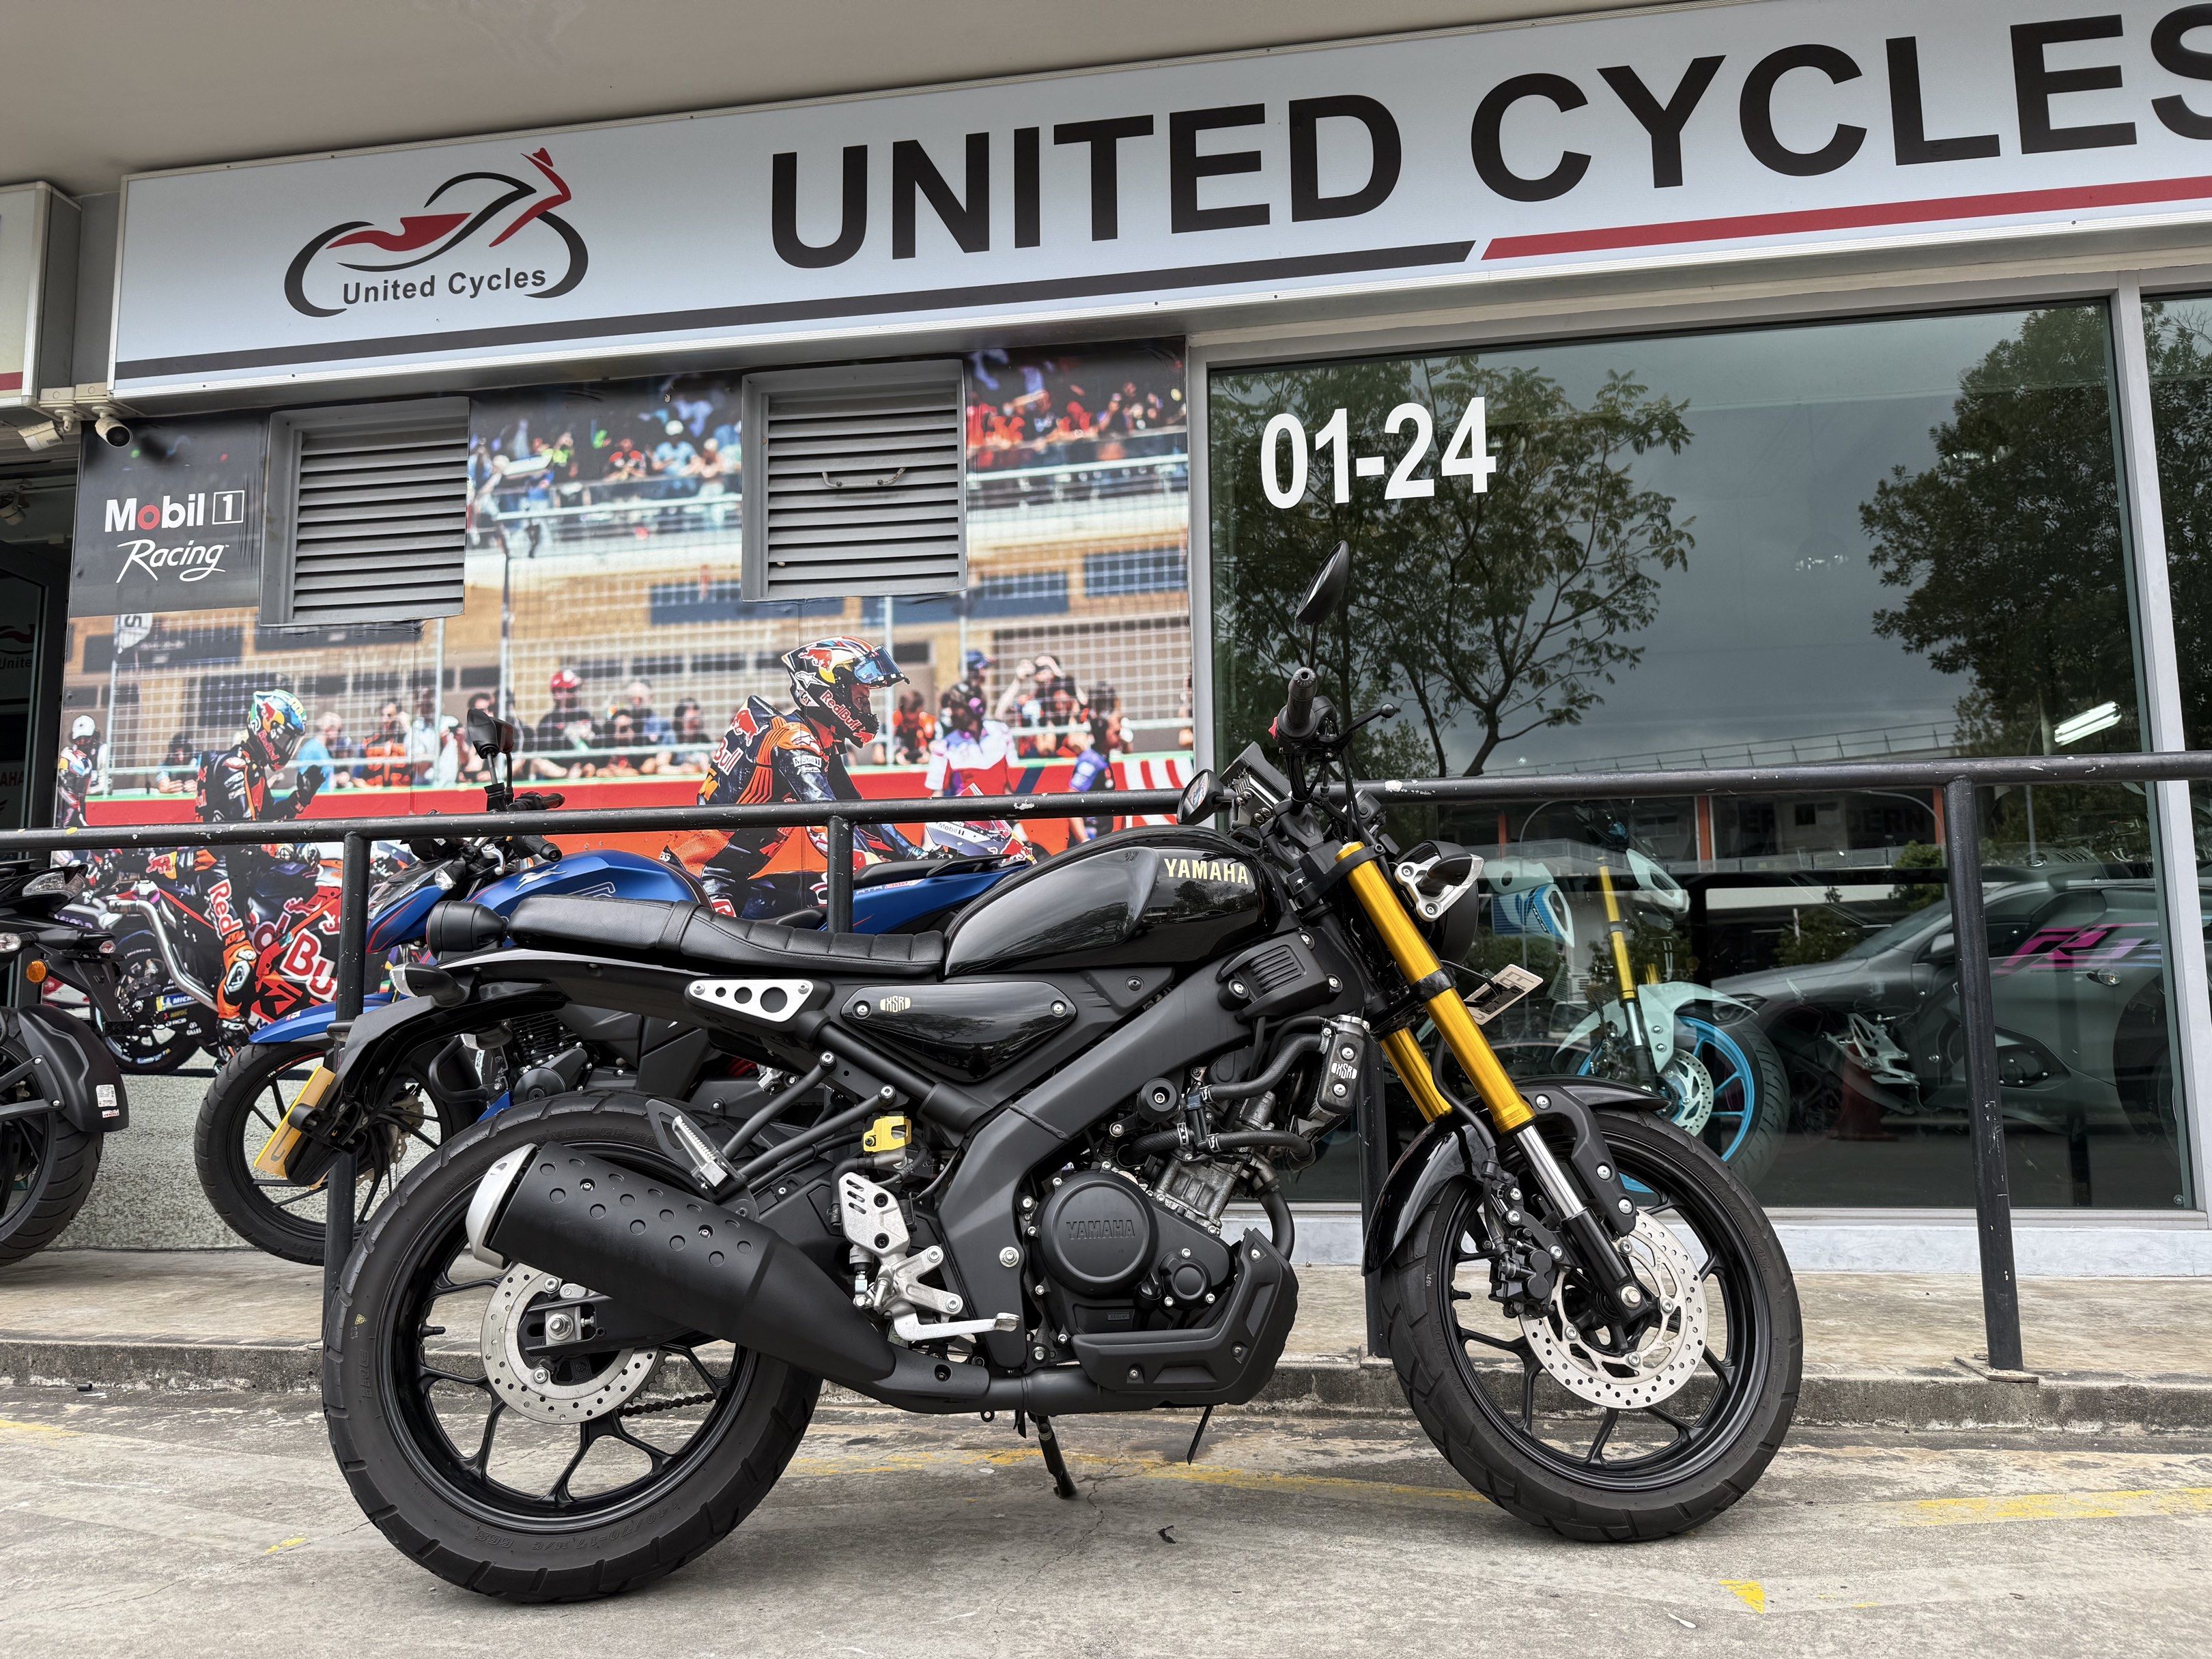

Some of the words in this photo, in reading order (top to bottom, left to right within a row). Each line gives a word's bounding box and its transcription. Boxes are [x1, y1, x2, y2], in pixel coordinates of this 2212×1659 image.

[771, 94, 1402, 269] UNITED
[343, 274, 436, 304] United
[448, 268, 546, 298] Cycles
[1261, 396, 1497, 509] 01-24
[104, 492, 205, 533] Mobil
[115, 539, 227, 584] Racing
[0, 656, 32, 669] Unite
[938, 822, 958, 835] Mobil
[1163, 858, 1249, 885] YAMAHA
[207, 879, 244, 936] Red
[280, 928, 338, 1003] Bu
[885, 995, 905, 1012] XSR
[1334, 1062, 1355, 1079] XSR
[1066, 1219, 1136, 1240] YAMAHA
